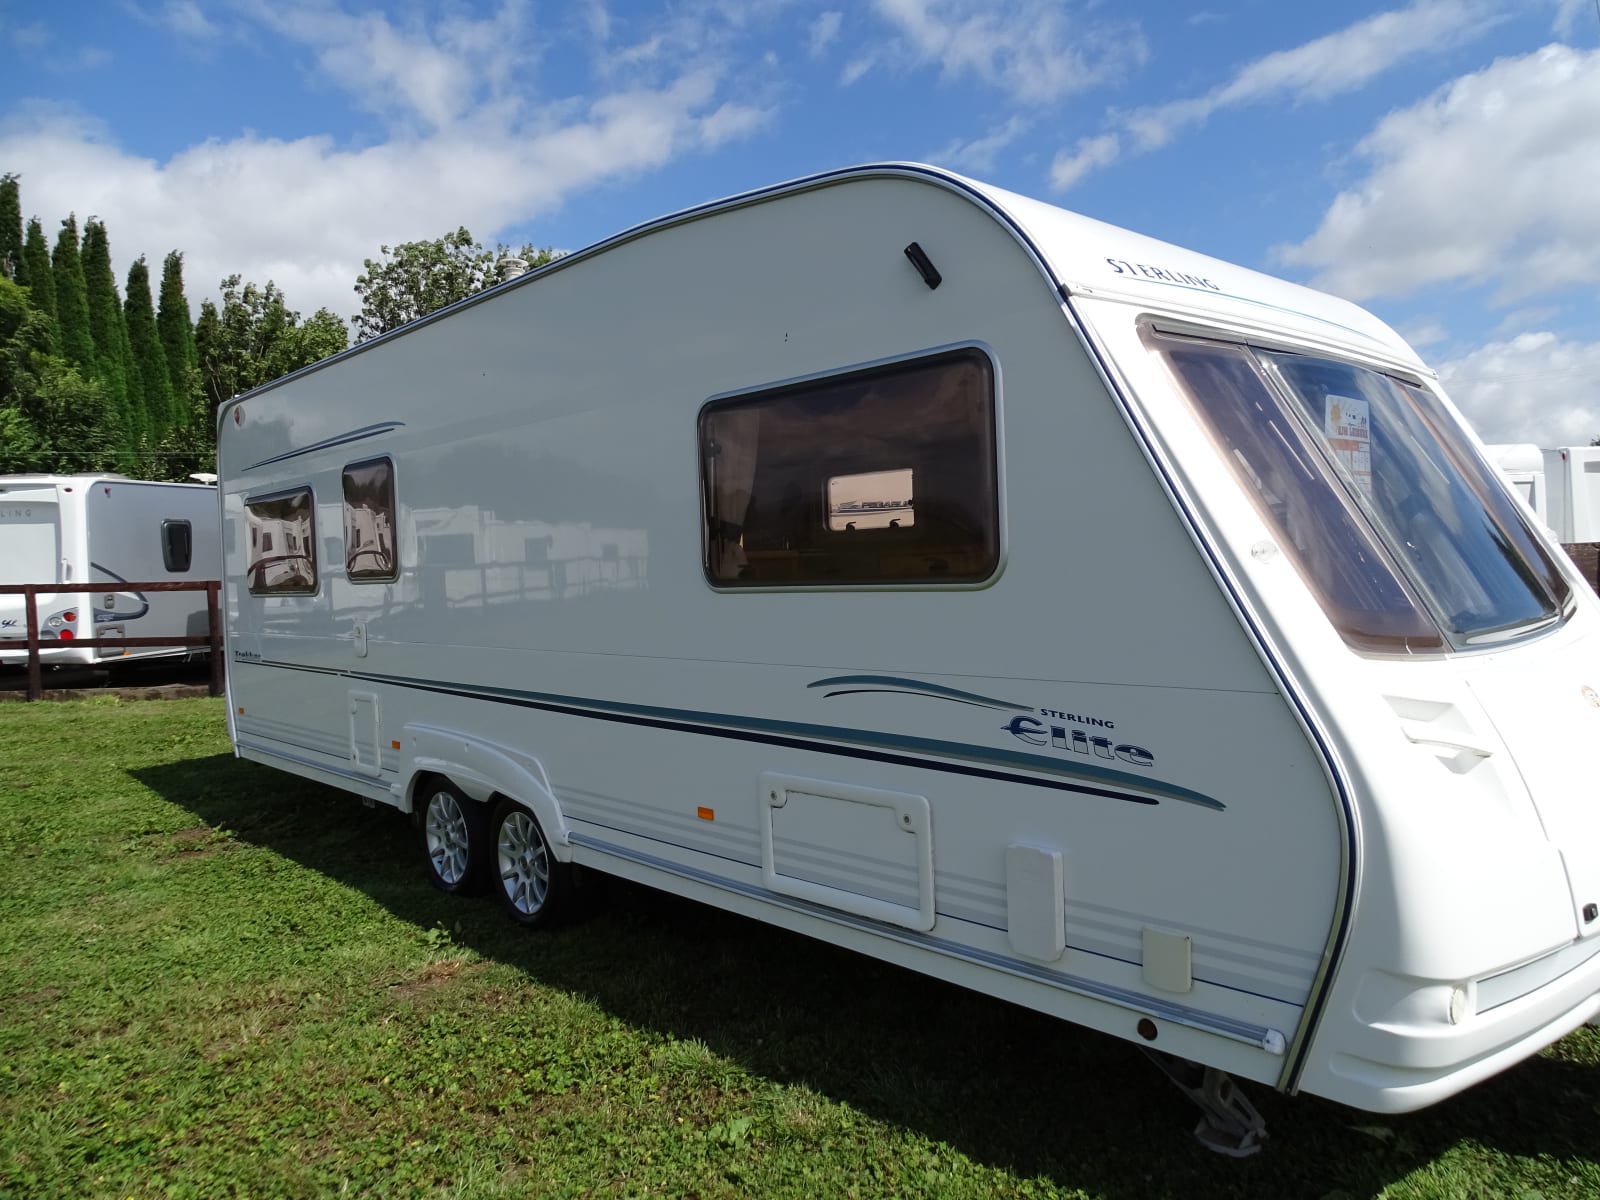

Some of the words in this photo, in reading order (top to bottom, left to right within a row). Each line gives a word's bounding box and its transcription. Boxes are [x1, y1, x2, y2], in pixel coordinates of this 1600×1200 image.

[1105, 258, 1220, 291] STERLING
[1040, 708, 1115, 729] STERLING
[1000, 715, 1155, 768] Elite
